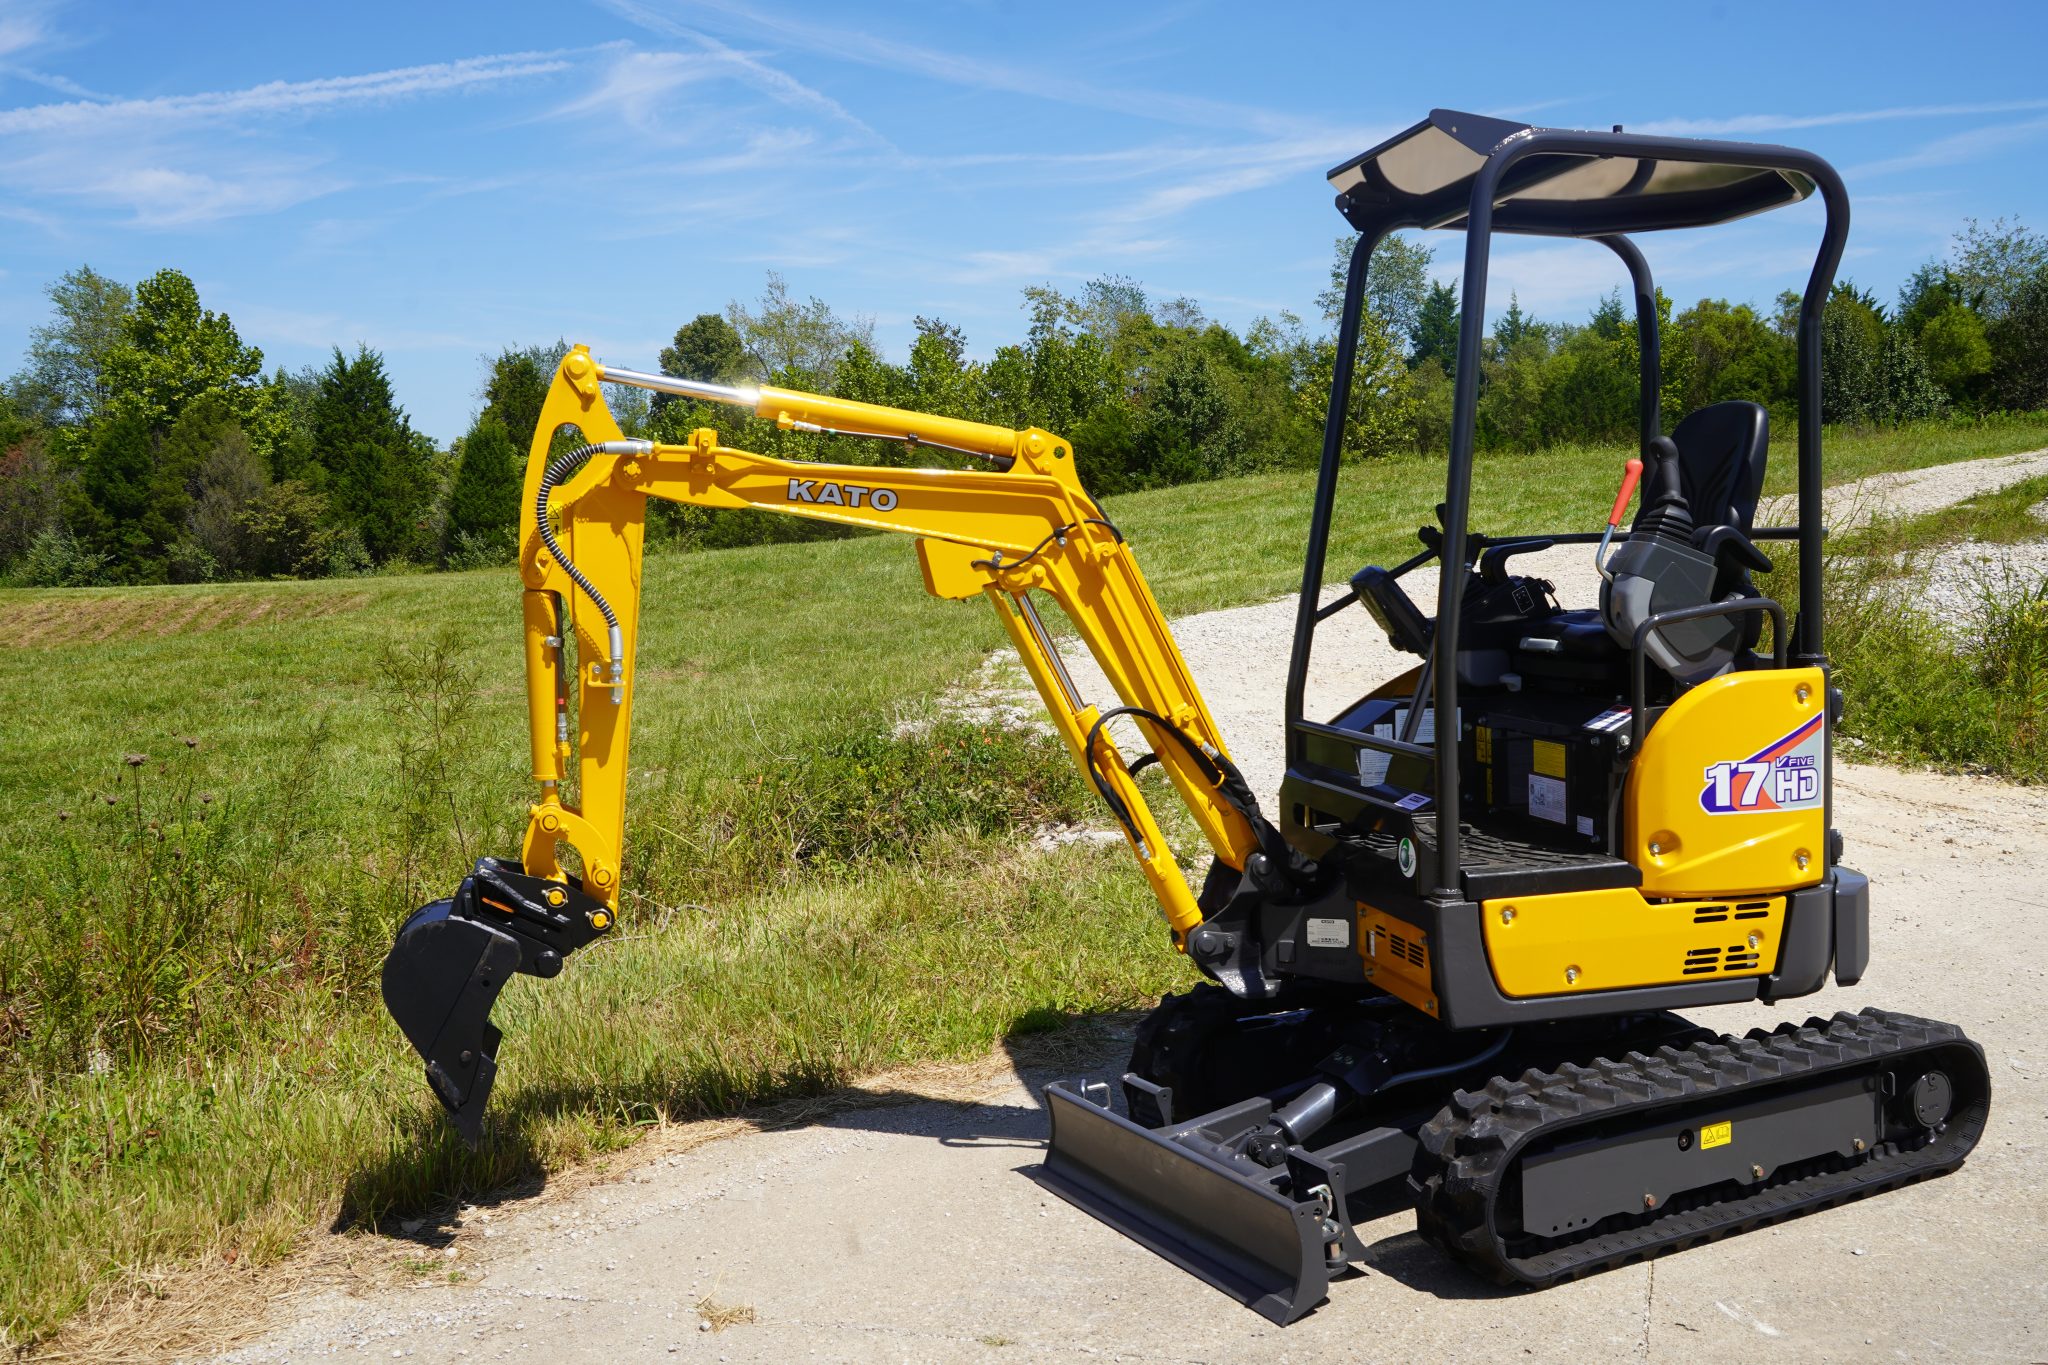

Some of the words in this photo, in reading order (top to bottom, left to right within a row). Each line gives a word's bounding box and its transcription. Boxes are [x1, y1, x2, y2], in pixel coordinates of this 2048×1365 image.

[787, 478, 898, 511] KATO
[1706, 761, 1771, 807] 17
[1776, 767, 1818, 803] HD
